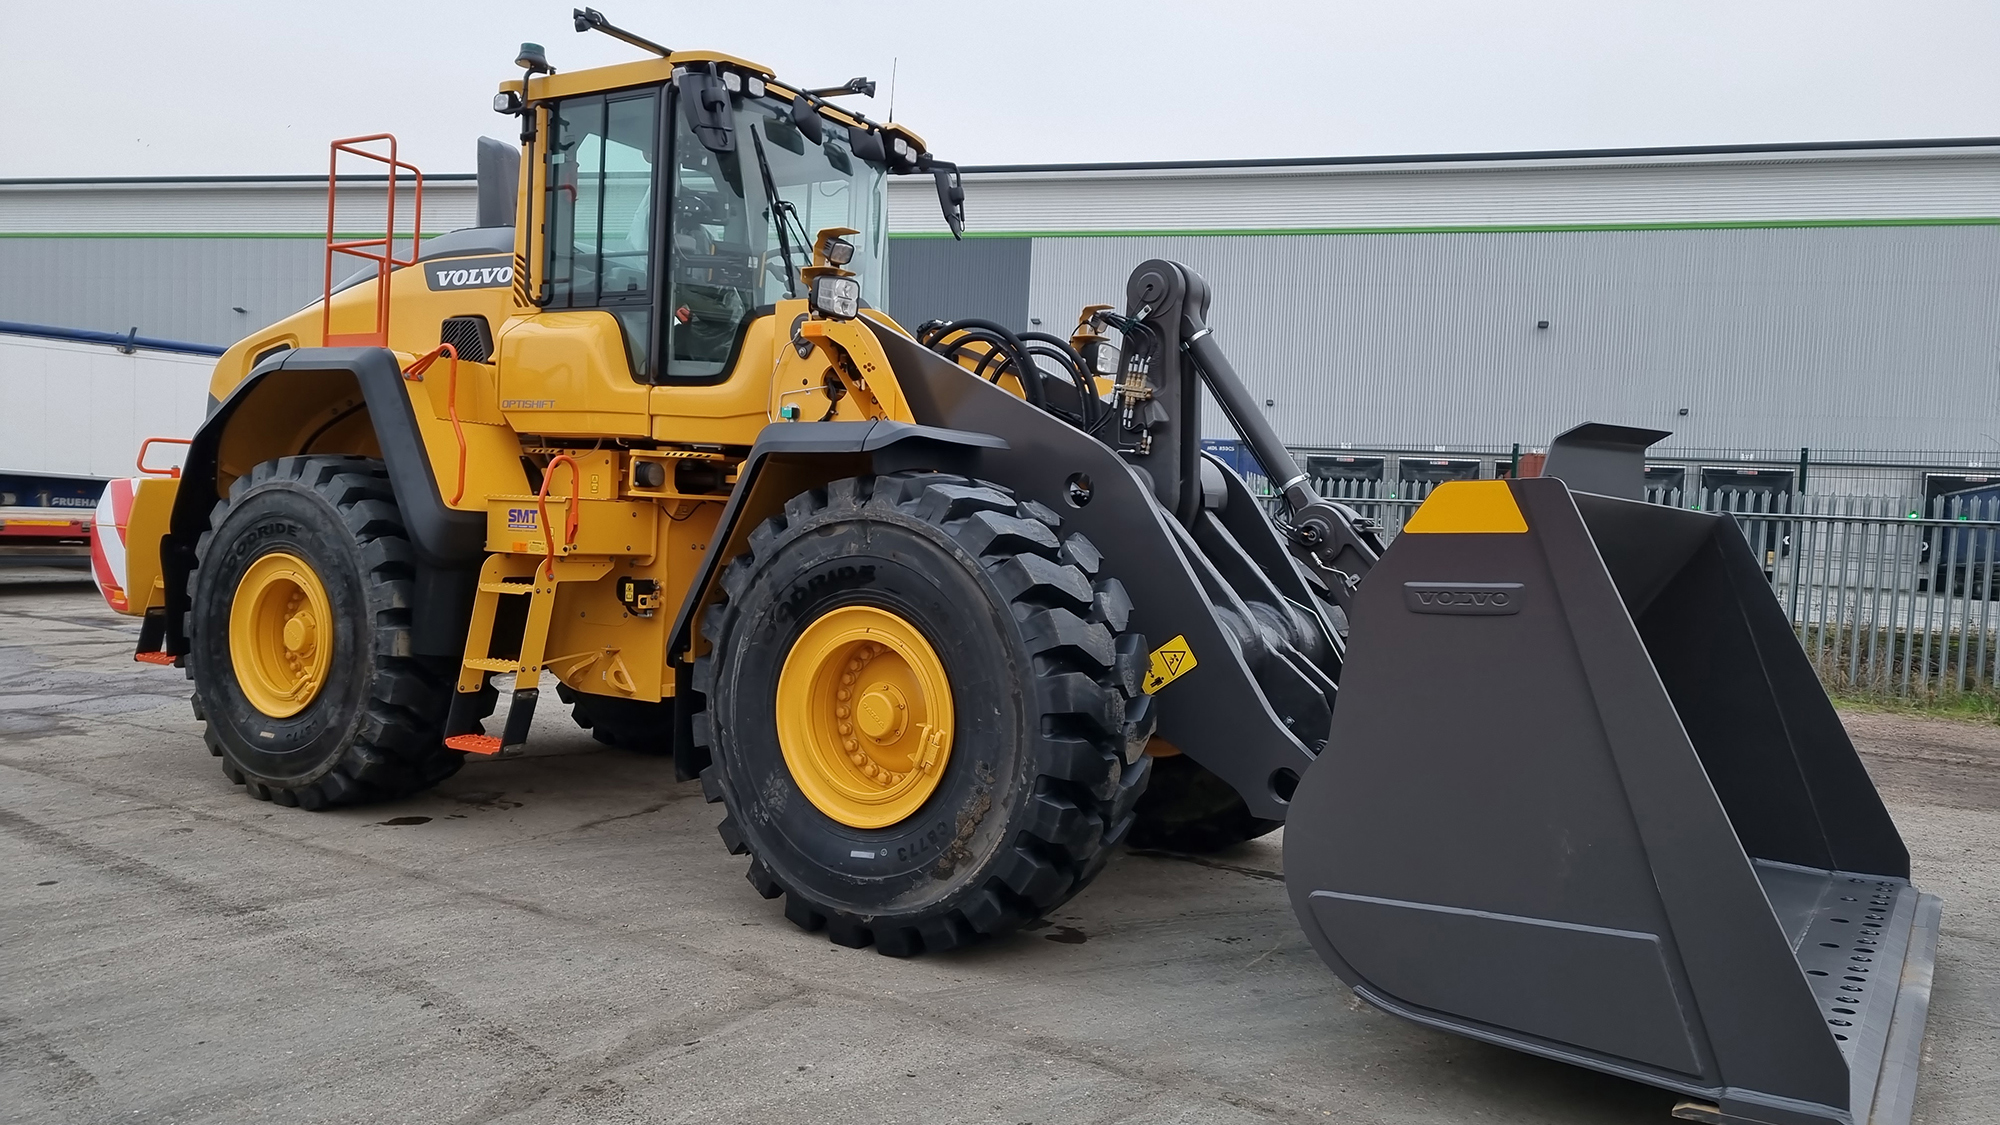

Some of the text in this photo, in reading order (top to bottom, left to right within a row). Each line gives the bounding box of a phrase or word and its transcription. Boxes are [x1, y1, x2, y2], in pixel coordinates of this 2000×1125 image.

[436, 266, 514, 287] VOLVO
[501, 399, 556, 409] OPTISHIFT
[51, 497, 99, 507] FRUEHA
[508, 508, 538, 523] SMT
[222, 522, 300, 578] OODRIDE
[761, 564, 877, 650] OODRIDE
[1414, 590, 1511, 607] VOLVO
[896, 820, 949, 863] CB773
